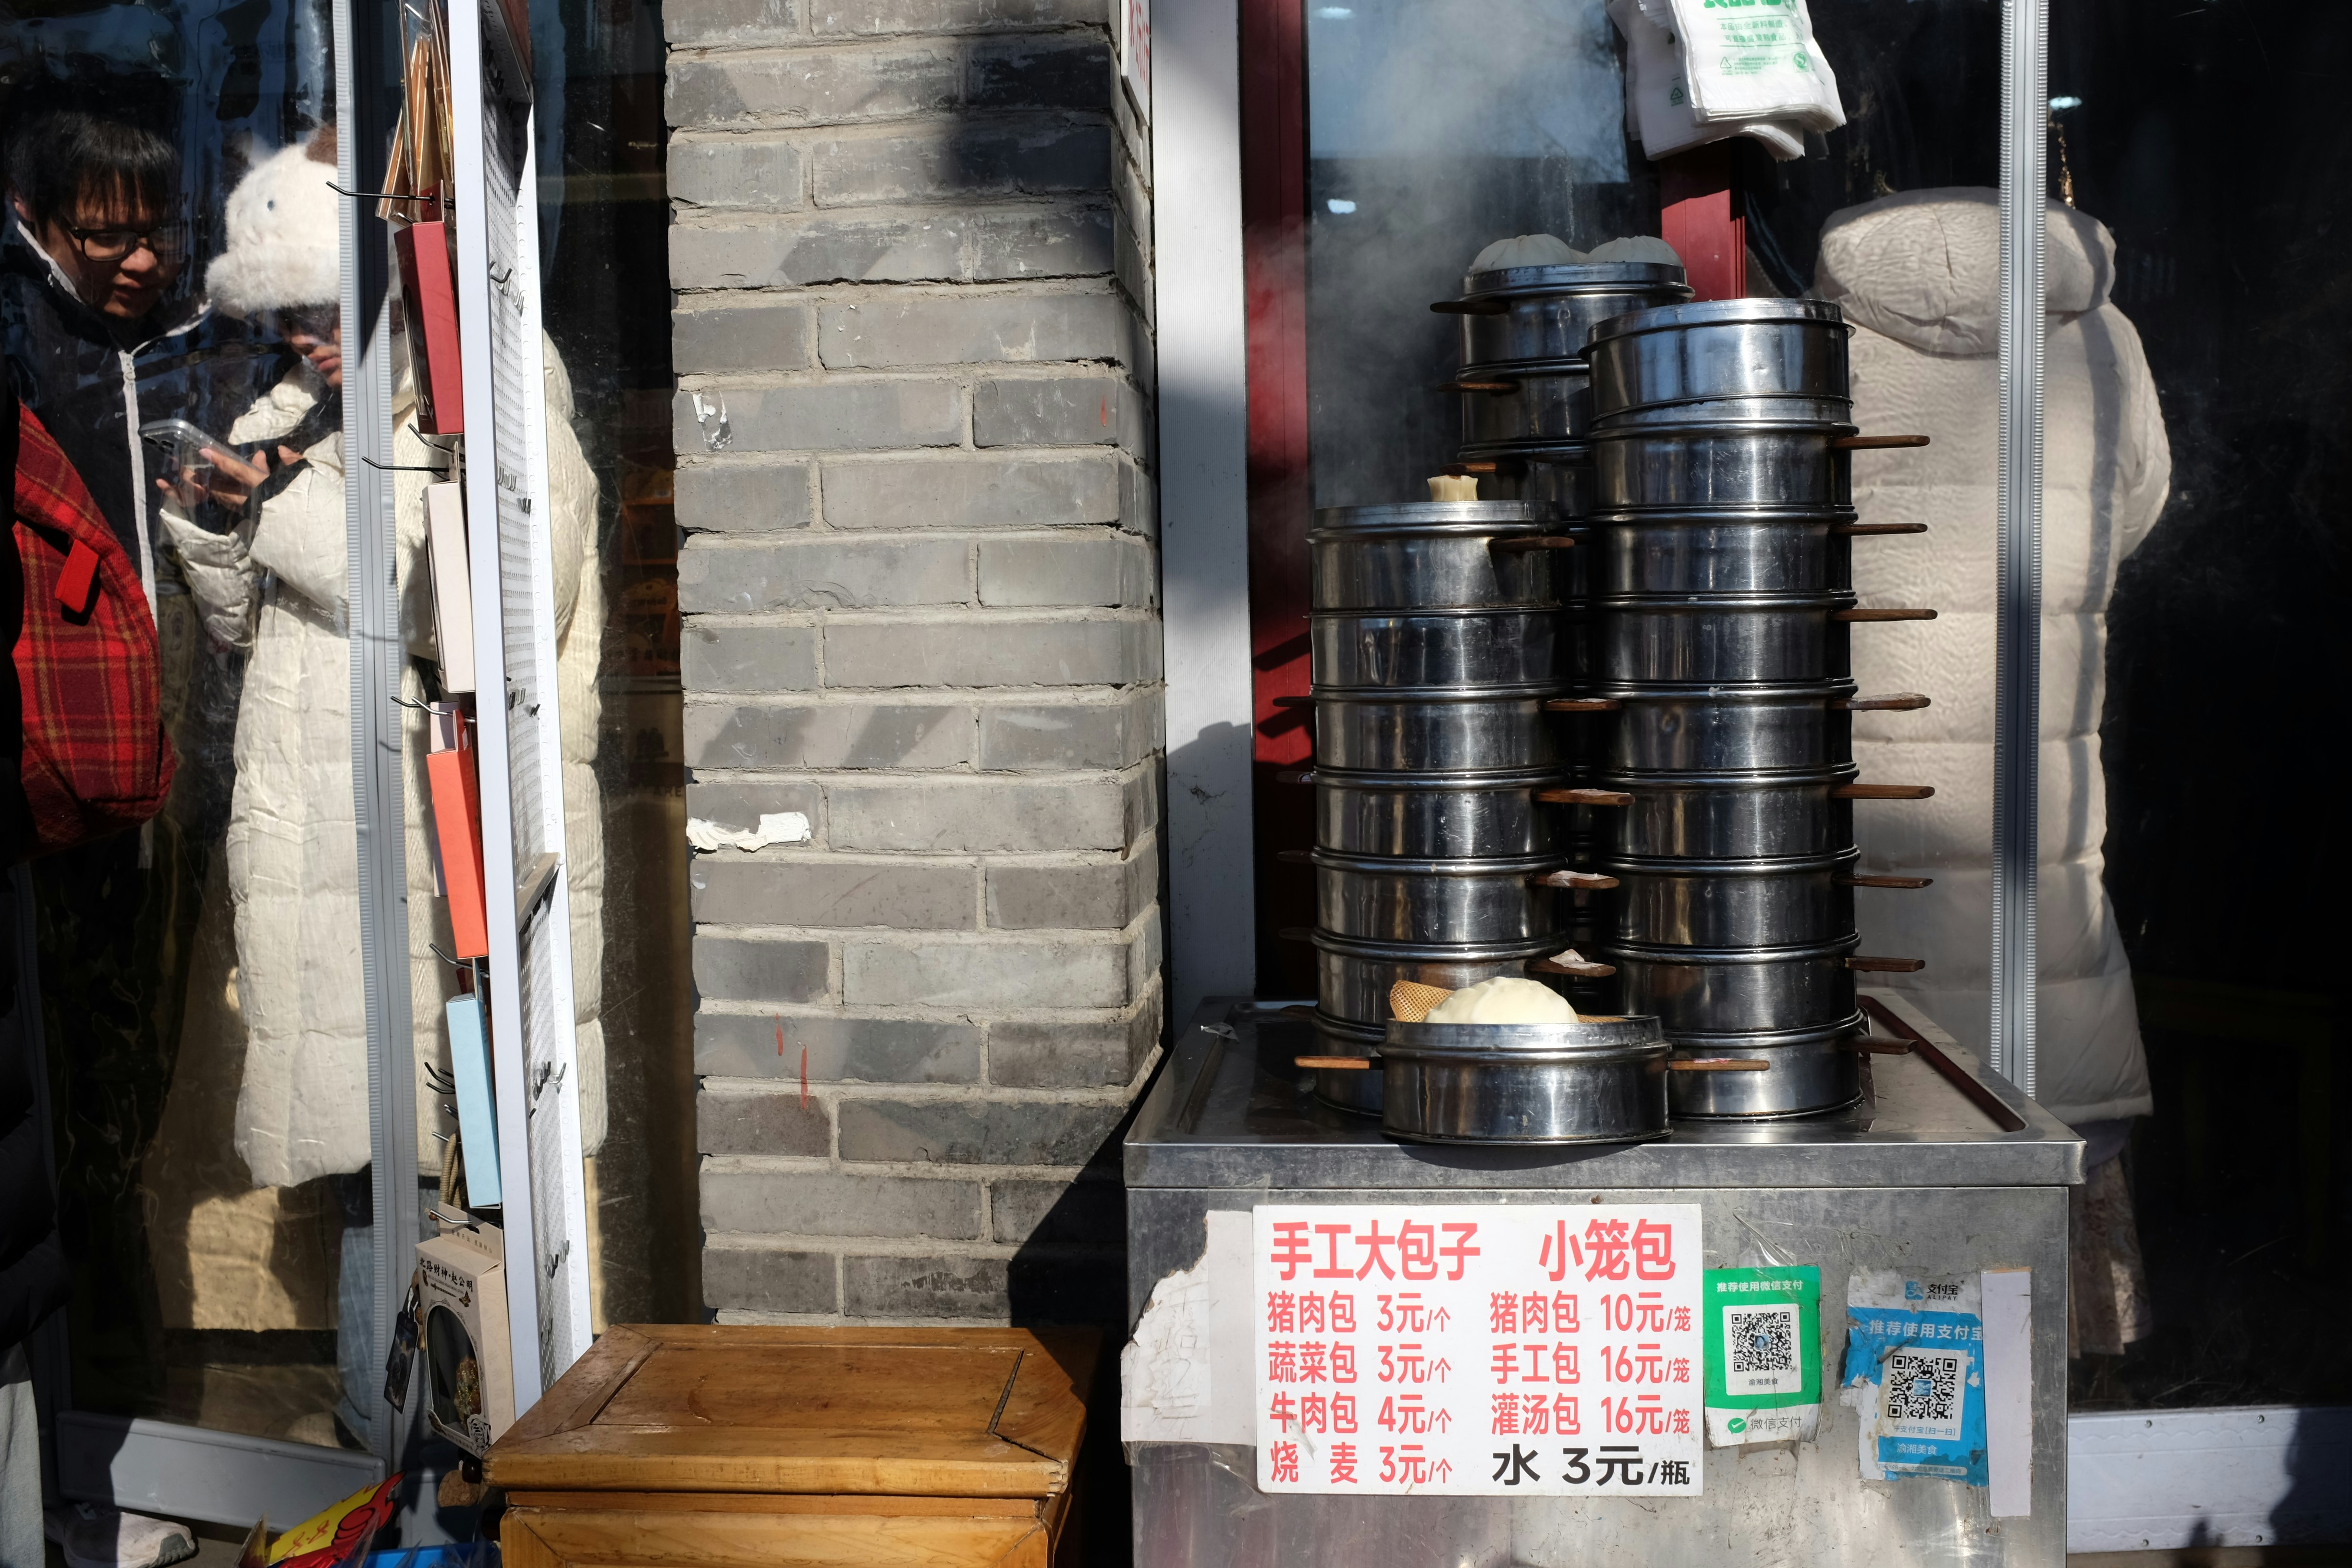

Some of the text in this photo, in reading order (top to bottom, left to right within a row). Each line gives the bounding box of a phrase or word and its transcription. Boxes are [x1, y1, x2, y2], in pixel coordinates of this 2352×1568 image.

[1271, 1220, 1480, 1281] 手工大包子
[1539, 1219, 1676, 1282] 小笼包
[1716, 1280, 1803, 1292] 推荐使用微信支付
[1927, 1284, 1959, 1295] 支付宝
[1268, 1290, 1356, 1333] 猪肉包
[1377, 1293, 1450, 1333] 3元/个
[1490, 1290, 1690, 1334] 猪肉包 10元/笼
[1869, 1320, 1983, 1341] 推荐使用支付宝
[1268, 1341, 1451, 1384] 蔬菜包 3元/个
[1491, 1342, 1690, 1384] 手工包 16元/笼
[1270, 1391, 1451, 1433] 牛肉包 4元/个
[1492, 1393, 1690, 1435] 灌汤包 16元/笼
[1751, 1416, 1802, 1430] 微信支付
[1379, 1445, 1452, 1483] 3元/个
[1493, 1444, 1690, 1486] 水 3元/瓶
[1897, 1443, 1937, 1455] 渝湘美食
